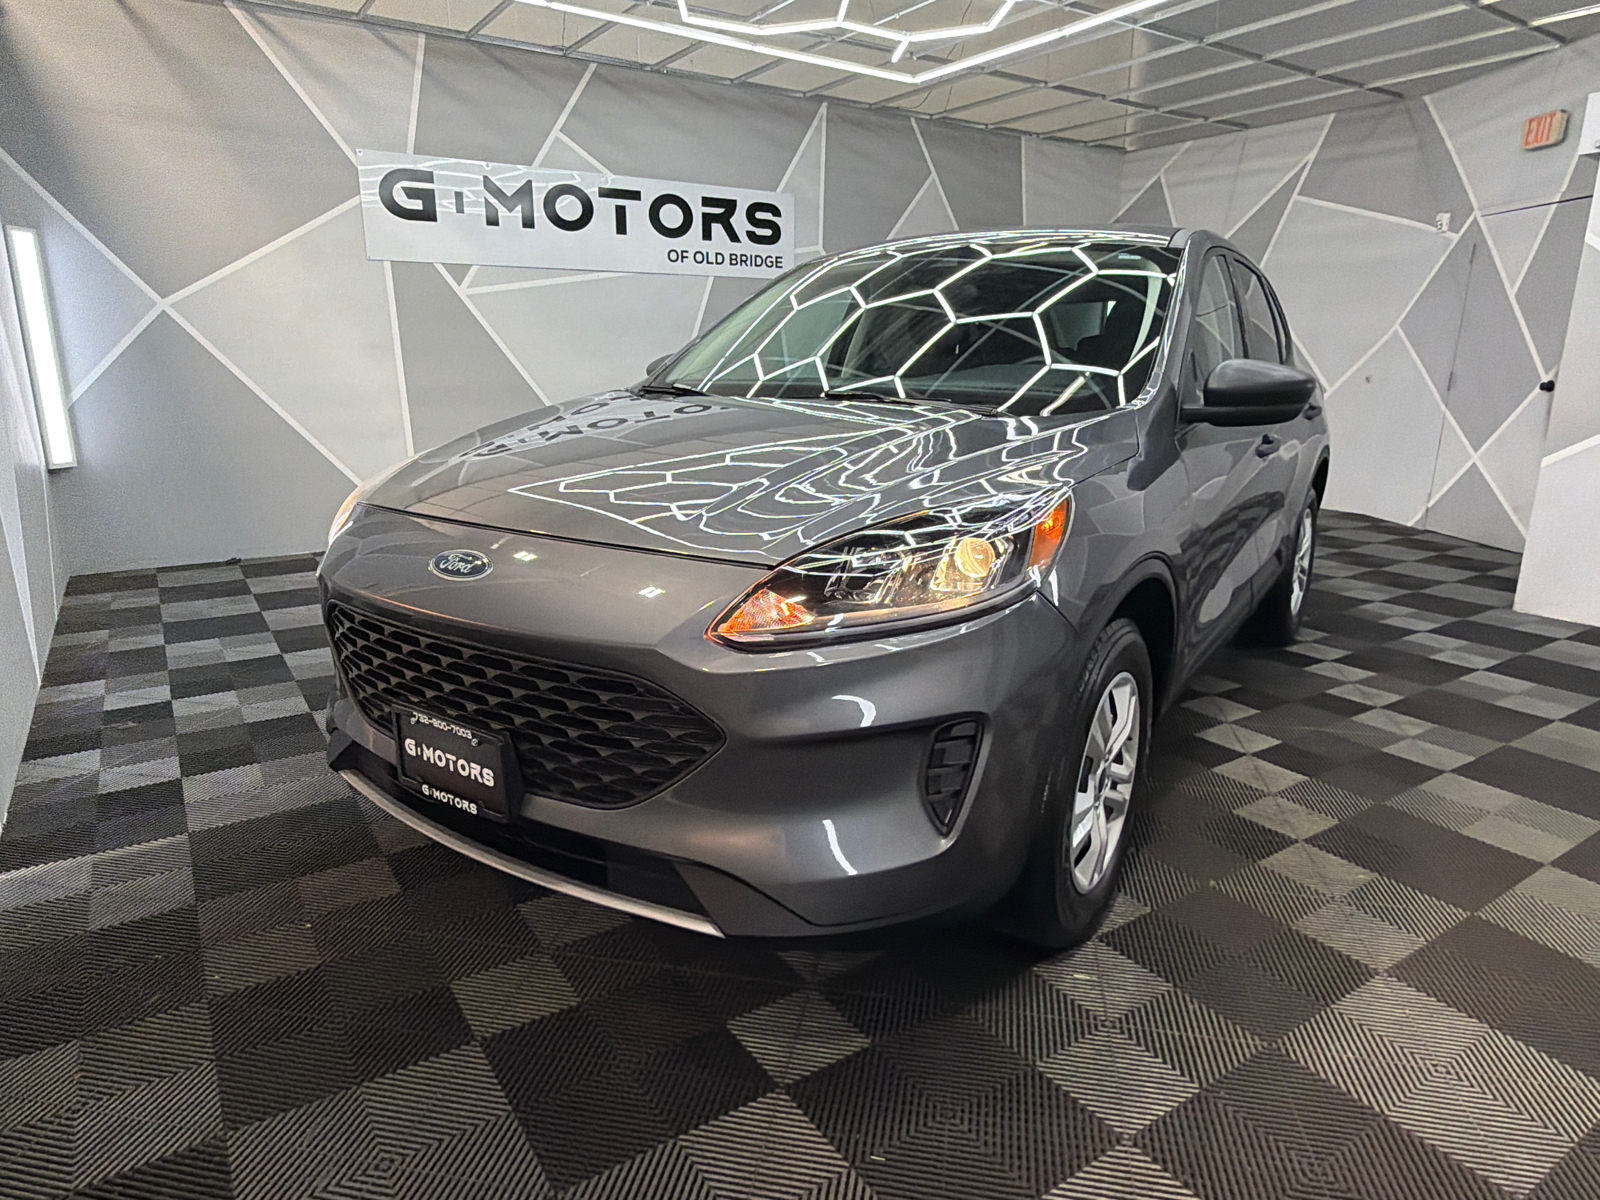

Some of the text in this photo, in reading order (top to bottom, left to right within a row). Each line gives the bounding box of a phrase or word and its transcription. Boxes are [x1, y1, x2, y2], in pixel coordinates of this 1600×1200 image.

[1524, 112, 1557, 147] EXIT
[667, 249, 783, 269] OF OLD BRIDGE
[440, 553, 482, 574] Ford
